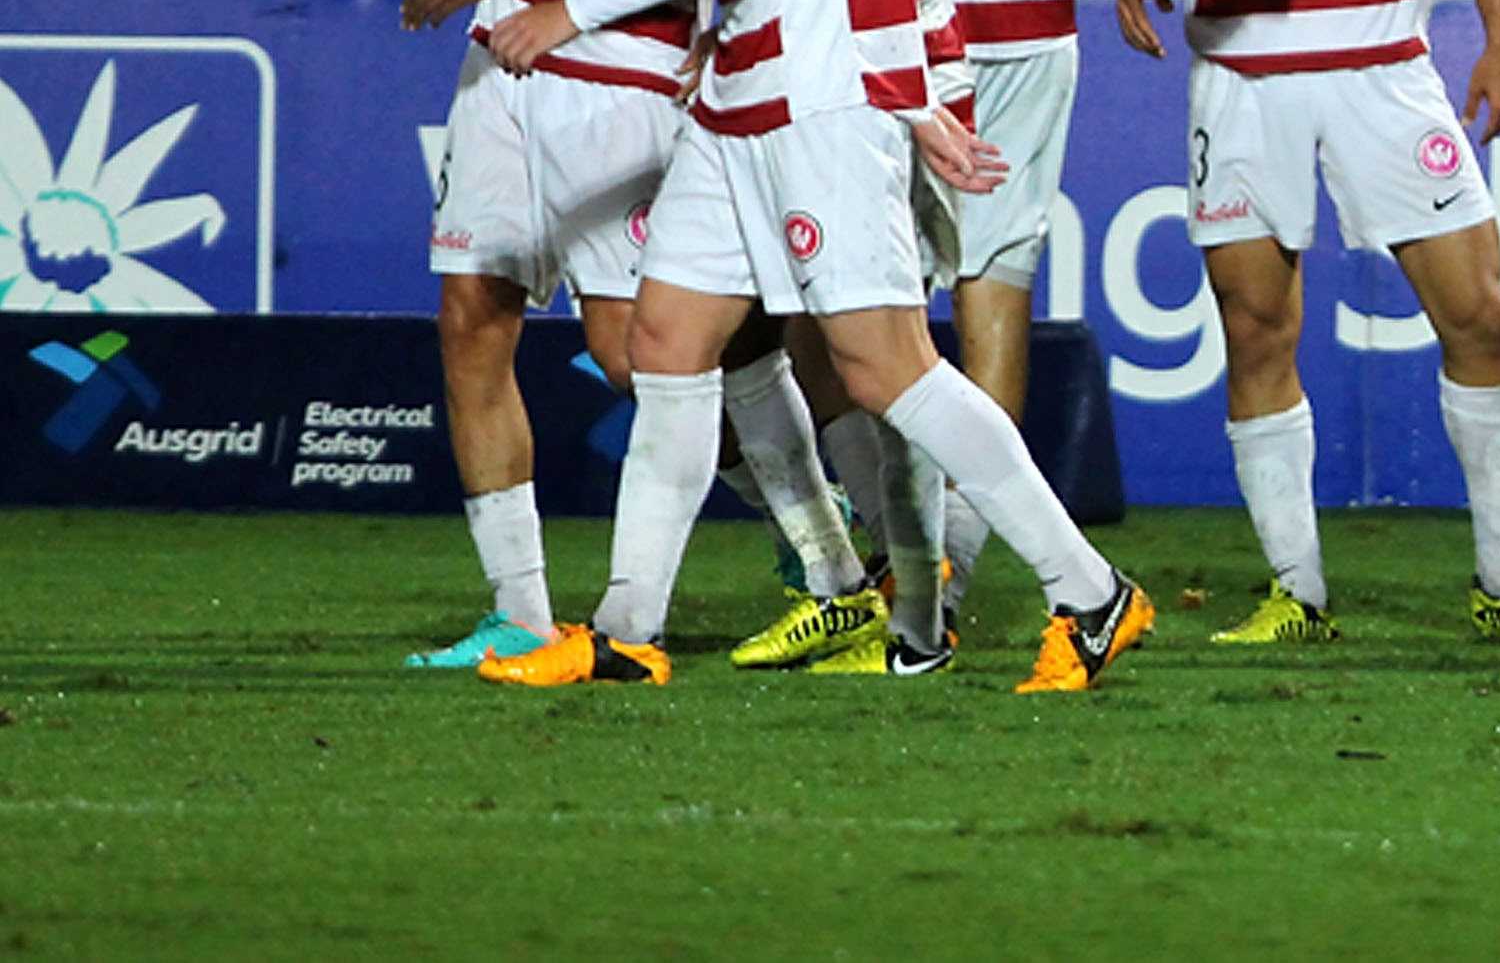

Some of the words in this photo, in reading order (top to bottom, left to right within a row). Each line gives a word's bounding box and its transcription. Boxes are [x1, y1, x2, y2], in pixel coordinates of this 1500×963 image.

[305, 400, 434, 428] Electrical
[115, 421, 264, 463] Ausgrid
[297, 431, 387, 461] Safety
[291, 462, 414, 488] program
